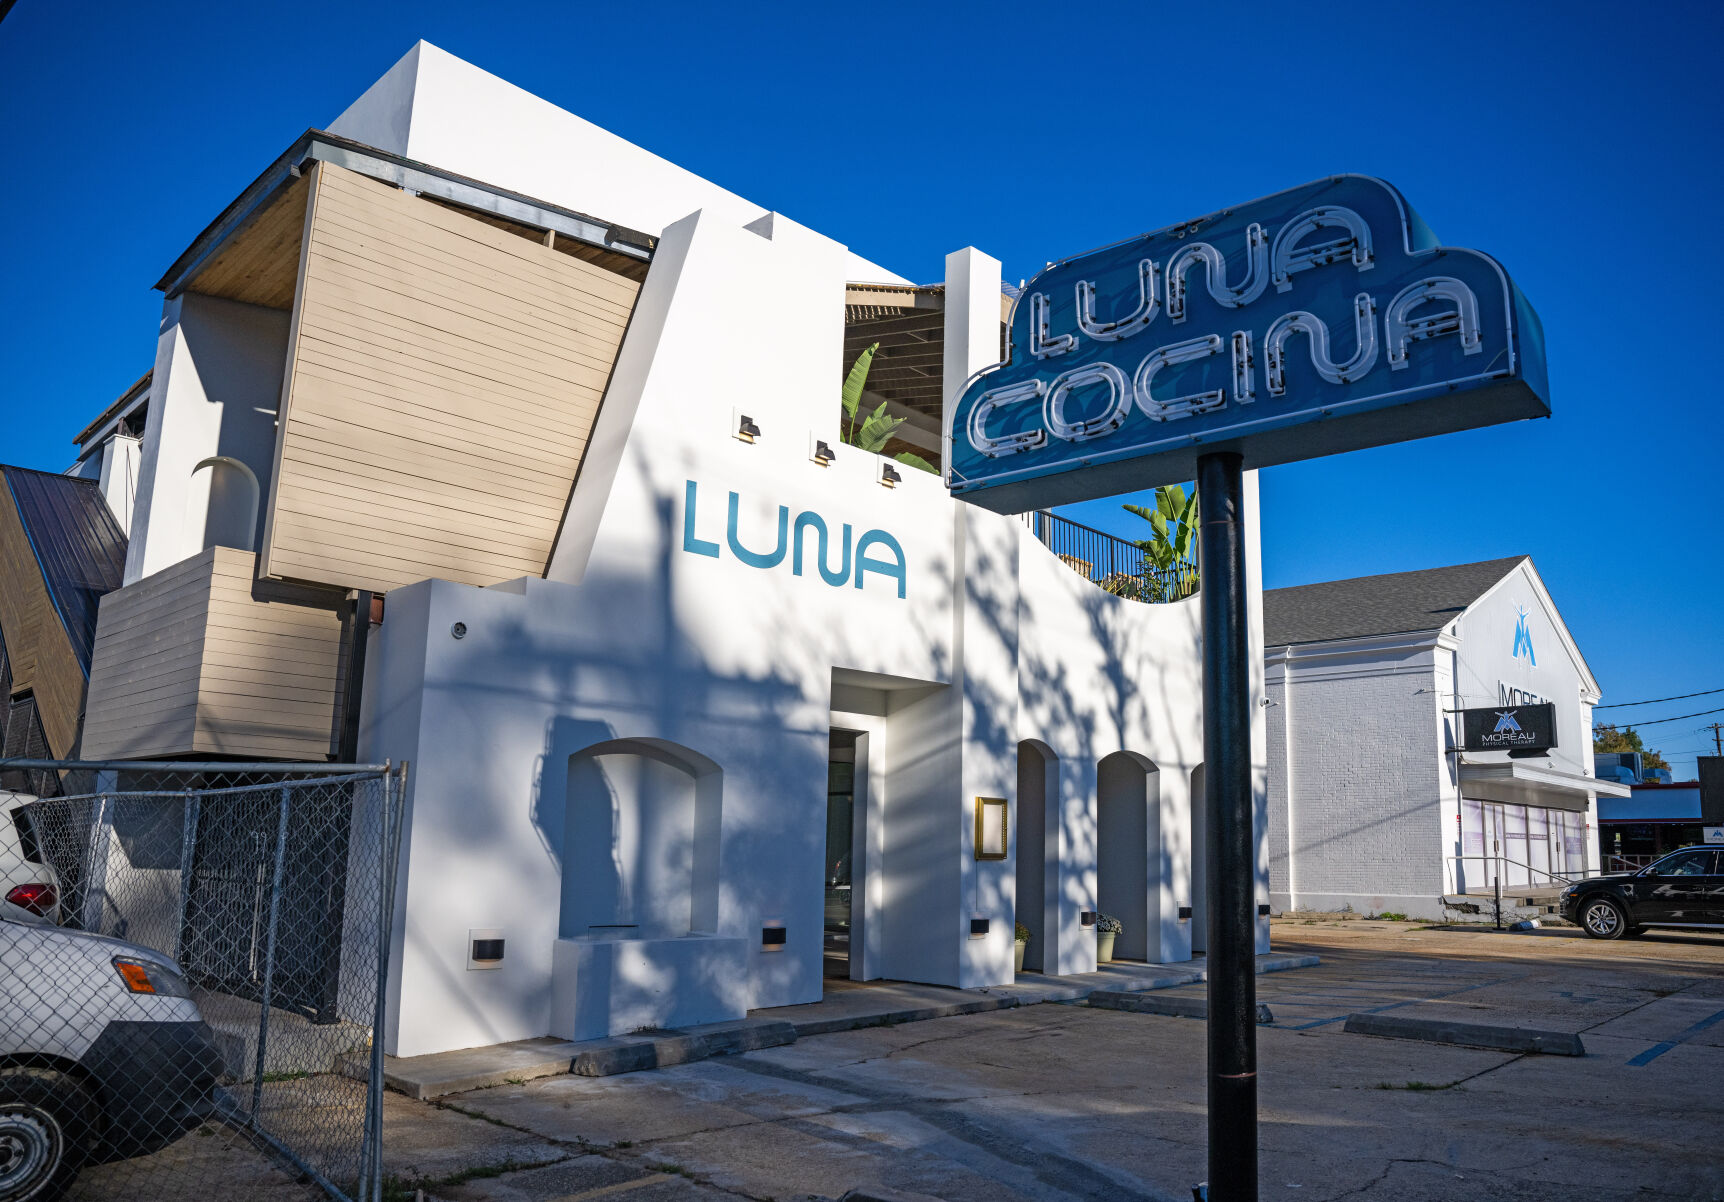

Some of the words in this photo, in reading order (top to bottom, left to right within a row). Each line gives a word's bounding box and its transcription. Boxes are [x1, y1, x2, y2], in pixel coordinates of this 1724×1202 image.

[1030, 206, 1375, 360] LUNA
[967, 276, 1482, 457] COCINA
[683, 480, 906, 599] LUNA
[1481, 732, 1535, 741] MOREAU
[1501, 683, 1548, 707] MORE
